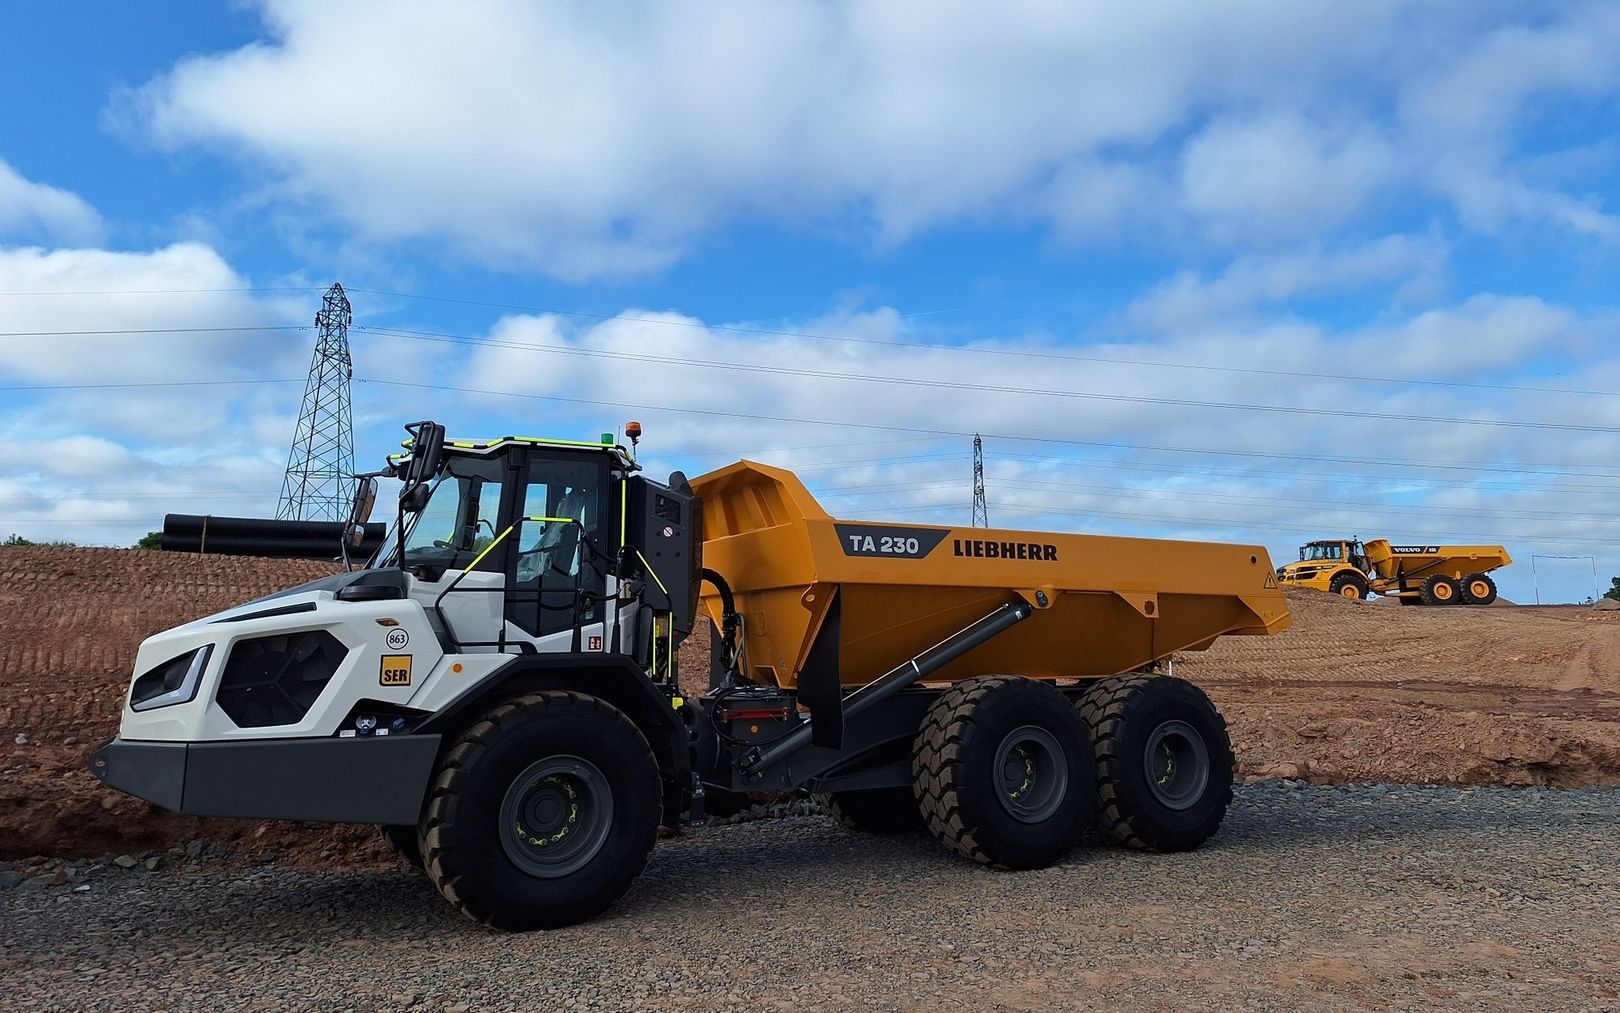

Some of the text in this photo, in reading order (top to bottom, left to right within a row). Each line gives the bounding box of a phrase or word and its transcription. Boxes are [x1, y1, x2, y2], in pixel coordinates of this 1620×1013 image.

[850, 535, 918, 553] TA 230
[954, 540, 1058, 561] LIEBHERR
[390, 635, 405, 643] 863
[384, 670, 407, 681] SER
